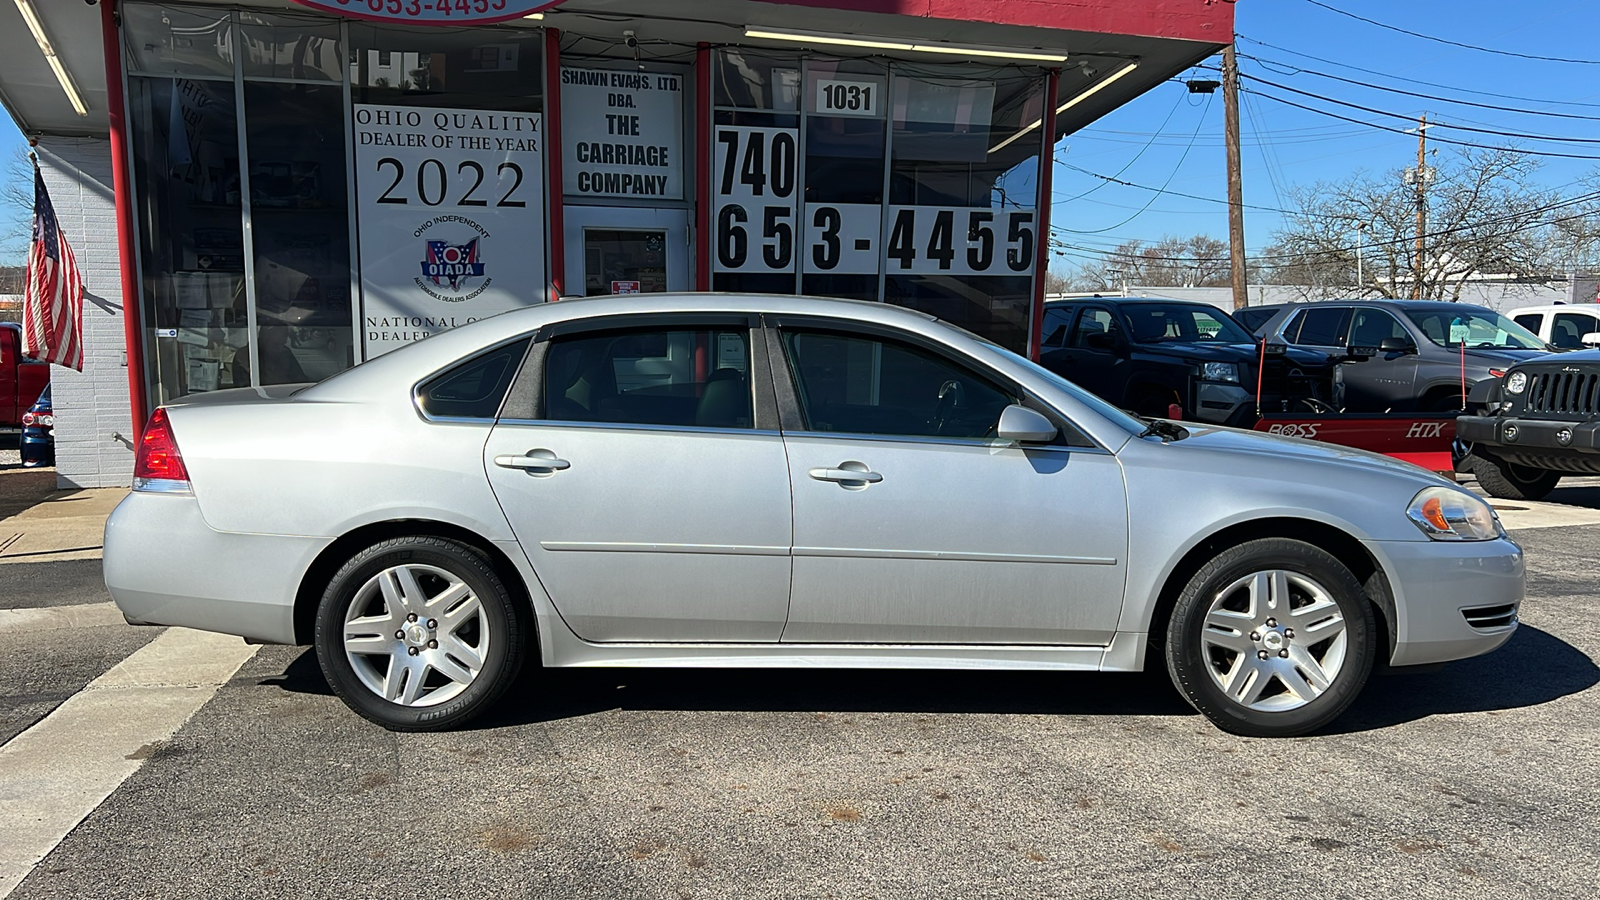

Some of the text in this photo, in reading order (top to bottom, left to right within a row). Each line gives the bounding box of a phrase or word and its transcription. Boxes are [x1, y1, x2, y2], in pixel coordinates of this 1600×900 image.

[336, 0, 506, 16] -653-4455
[562, 70, 680, 91] SHAWN EVANS. LTD.
[608, 93, 636, 108] DBA.
[823, 84, 871, 111] 1031
[356, 109, 540, 132] OHIO QUALITY
[606, 114, 640, 136] THE
[360, 132, 538, 152] DEALER OF THE YEAR
[576, 142, 668, 167] CARRIAGE
[718, 130, 795, 198] 740
[376, 157, 526, 208] 2022
[578, 171, 668, 195] COMPANY
[413, 215, 491, 239] OHIO INDEPENDENT
[428, 263, 475, 275] OIADA
[413, 277, 442, 301] AUTOMOBILE
[465, 277, 492, 301] ASSOCIATION
[366, 317, 459, 327] NATIONAL
[1268, 422, 1448, 438] BOSS HTX
[420, 695, 473, 721] MICHELIN
